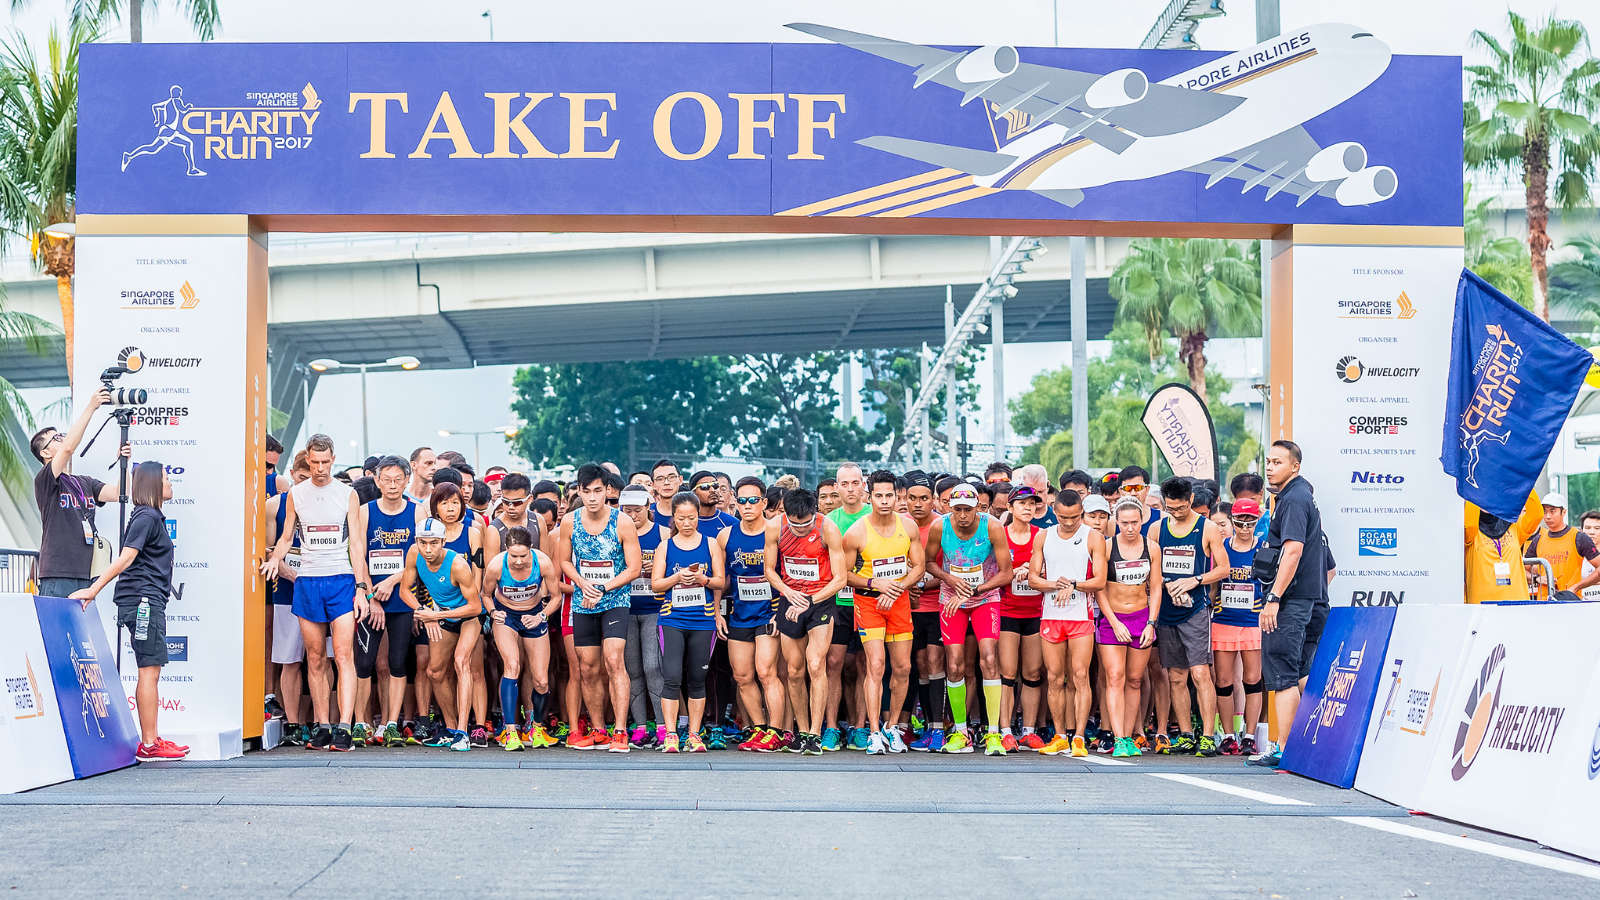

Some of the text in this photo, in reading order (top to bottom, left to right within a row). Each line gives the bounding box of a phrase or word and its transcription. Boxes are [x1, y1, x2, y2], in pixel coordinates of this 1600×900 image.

[1237, 32, 1312, 73] AIRLINES
[246, 92, 298, 100] SINGAPORE
[182, 111, 321, 135] CHARITY
[348, 90, 847, 160] TAKE OFF
[204, 136, 313, 160] RUN 2017
[120, 290, 175, 298] SINGAPORE
[1338, 300, 1392, 308] SINGAPORE
[148, 358, 202, 368] HIVELOCITY
[1509, 345, 1524, 374] 2017
[1367, 367, 1420, 377] HIVELOCITY
[1465, 331, 1516, 430] CHARITY
[131, 407, 189, 416] COMPRES
[1348, 416, 1408, 426] COMPRES
[1351, 471, 1405, 484] Nitto
[1350, 590, 1406, 608] RUN
[1488, 704, 1566, 754] HIVELOCITY
